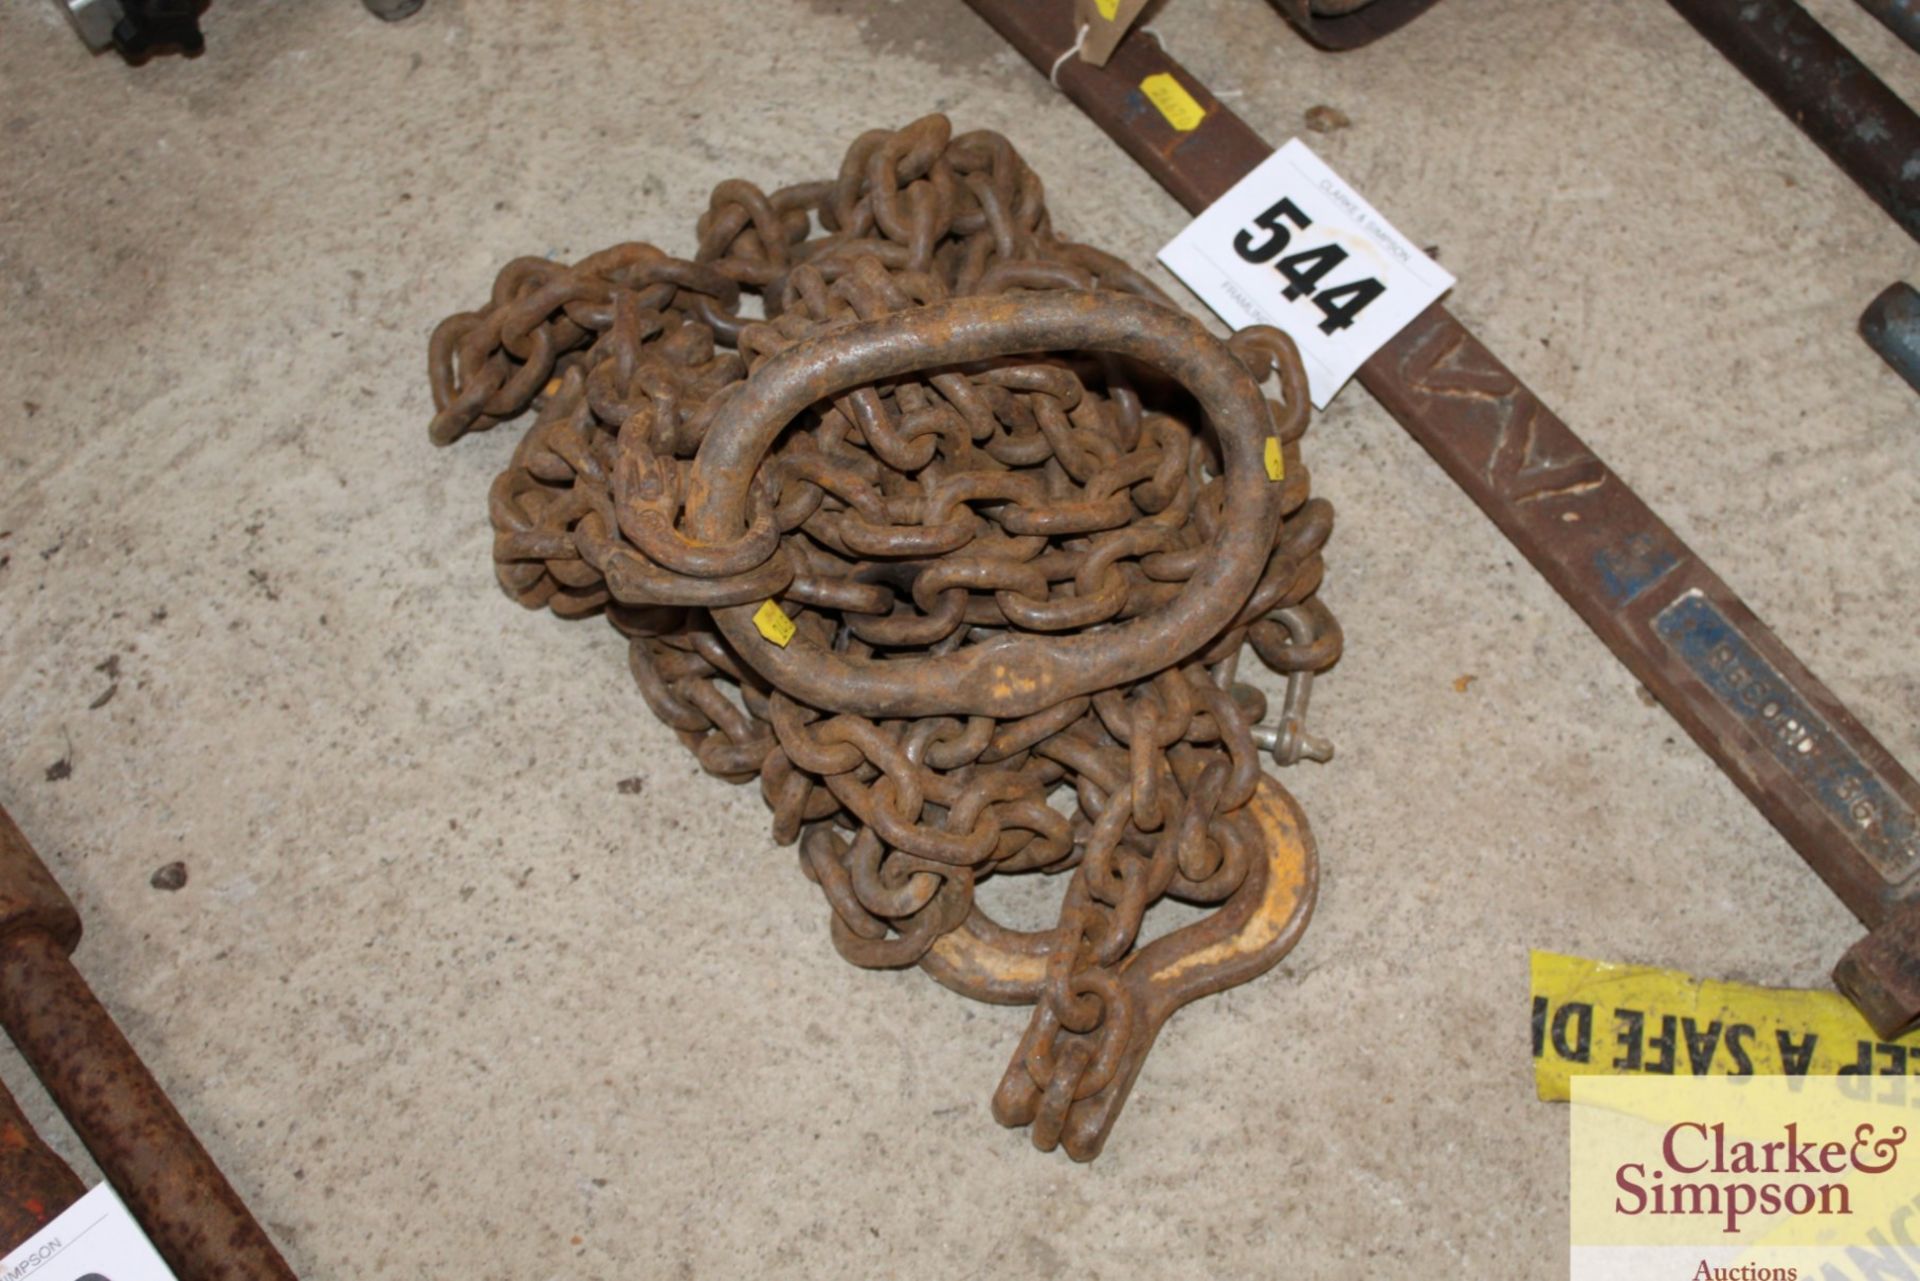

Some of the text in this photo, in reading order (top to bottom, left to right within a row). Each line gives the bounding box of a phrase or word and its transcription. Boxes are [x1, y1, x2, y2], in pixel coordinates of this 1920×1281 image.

[1233, 196, 1387, 335] 544
[1612, 1007, 1756, 1085] SAFE
[1775, 1029, 1818, 1093] A
